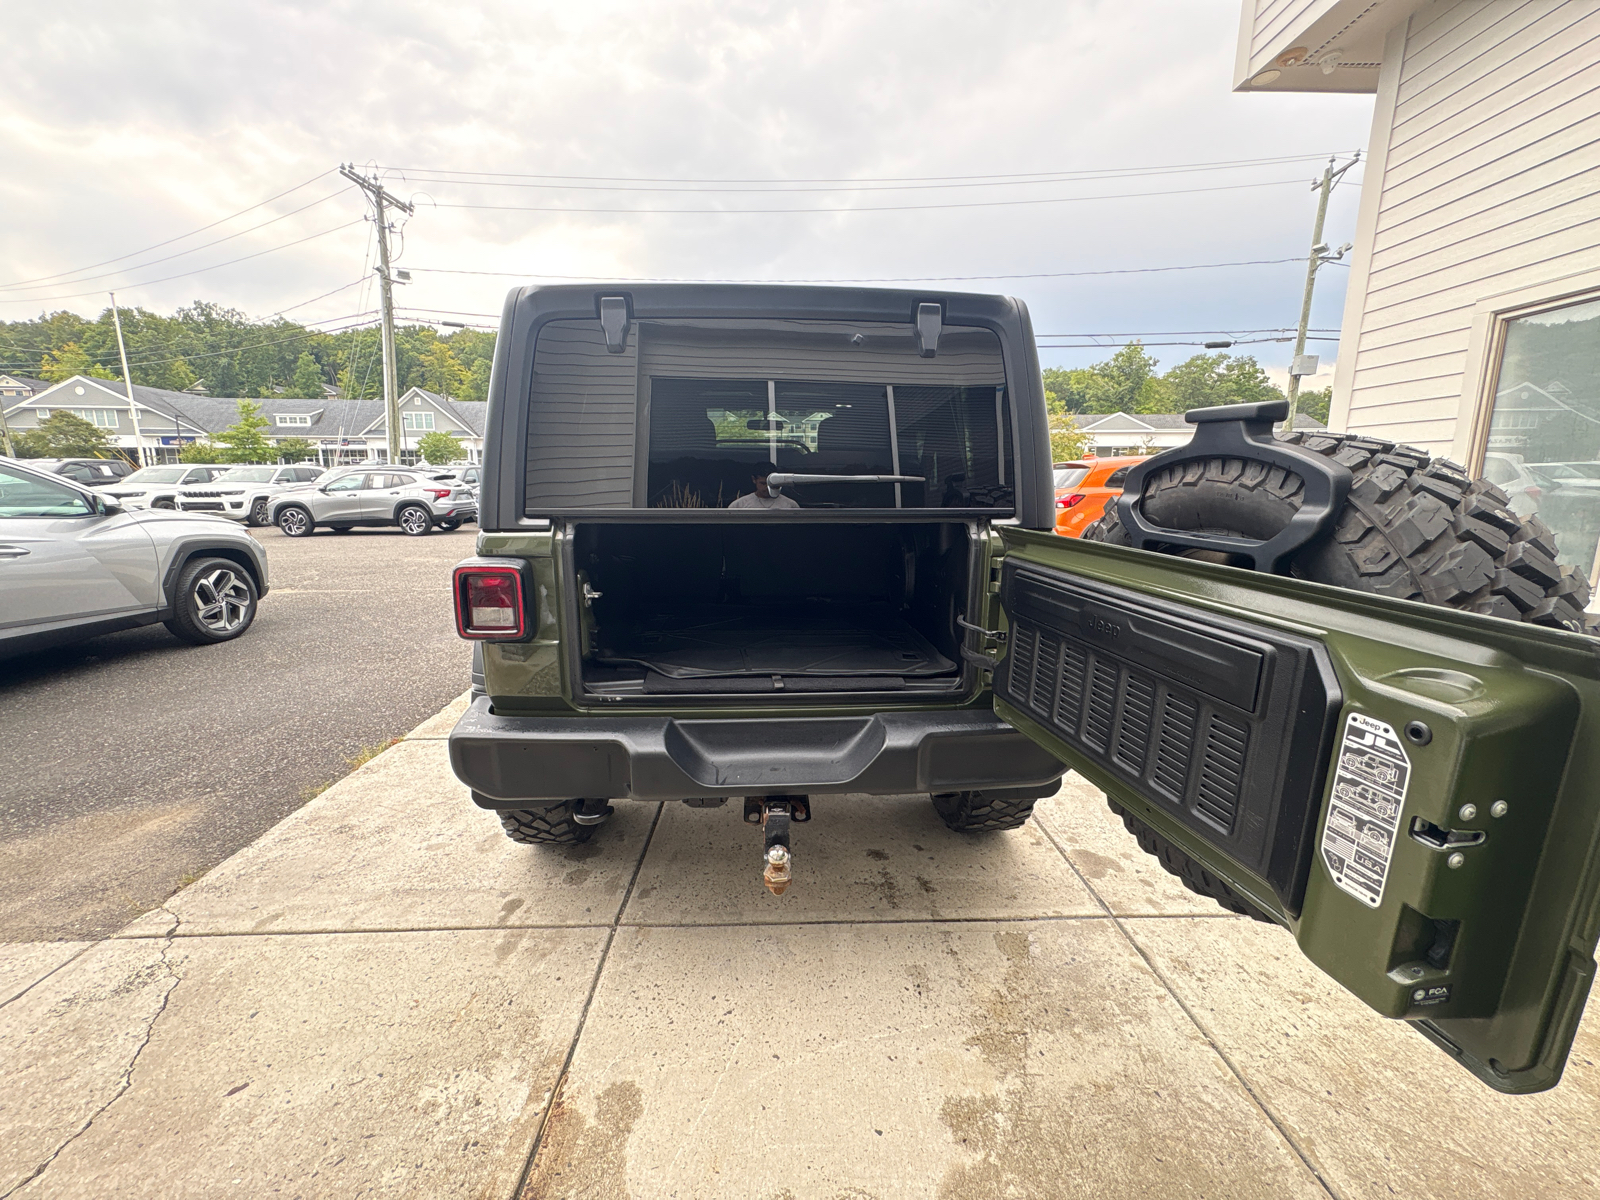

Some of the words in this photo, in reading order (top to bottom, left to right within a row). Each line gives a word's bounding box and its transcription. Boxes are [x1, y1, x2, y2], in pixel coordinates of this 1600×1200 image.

[1088, 614, 1120, 640] Jeep
[1359, 718, 1381, 731] Jeep
[1347, 732, 1402, 755] JL
[1355, 854, 1383, 875] USA
[1429, 987, 1447, 995] FCA
